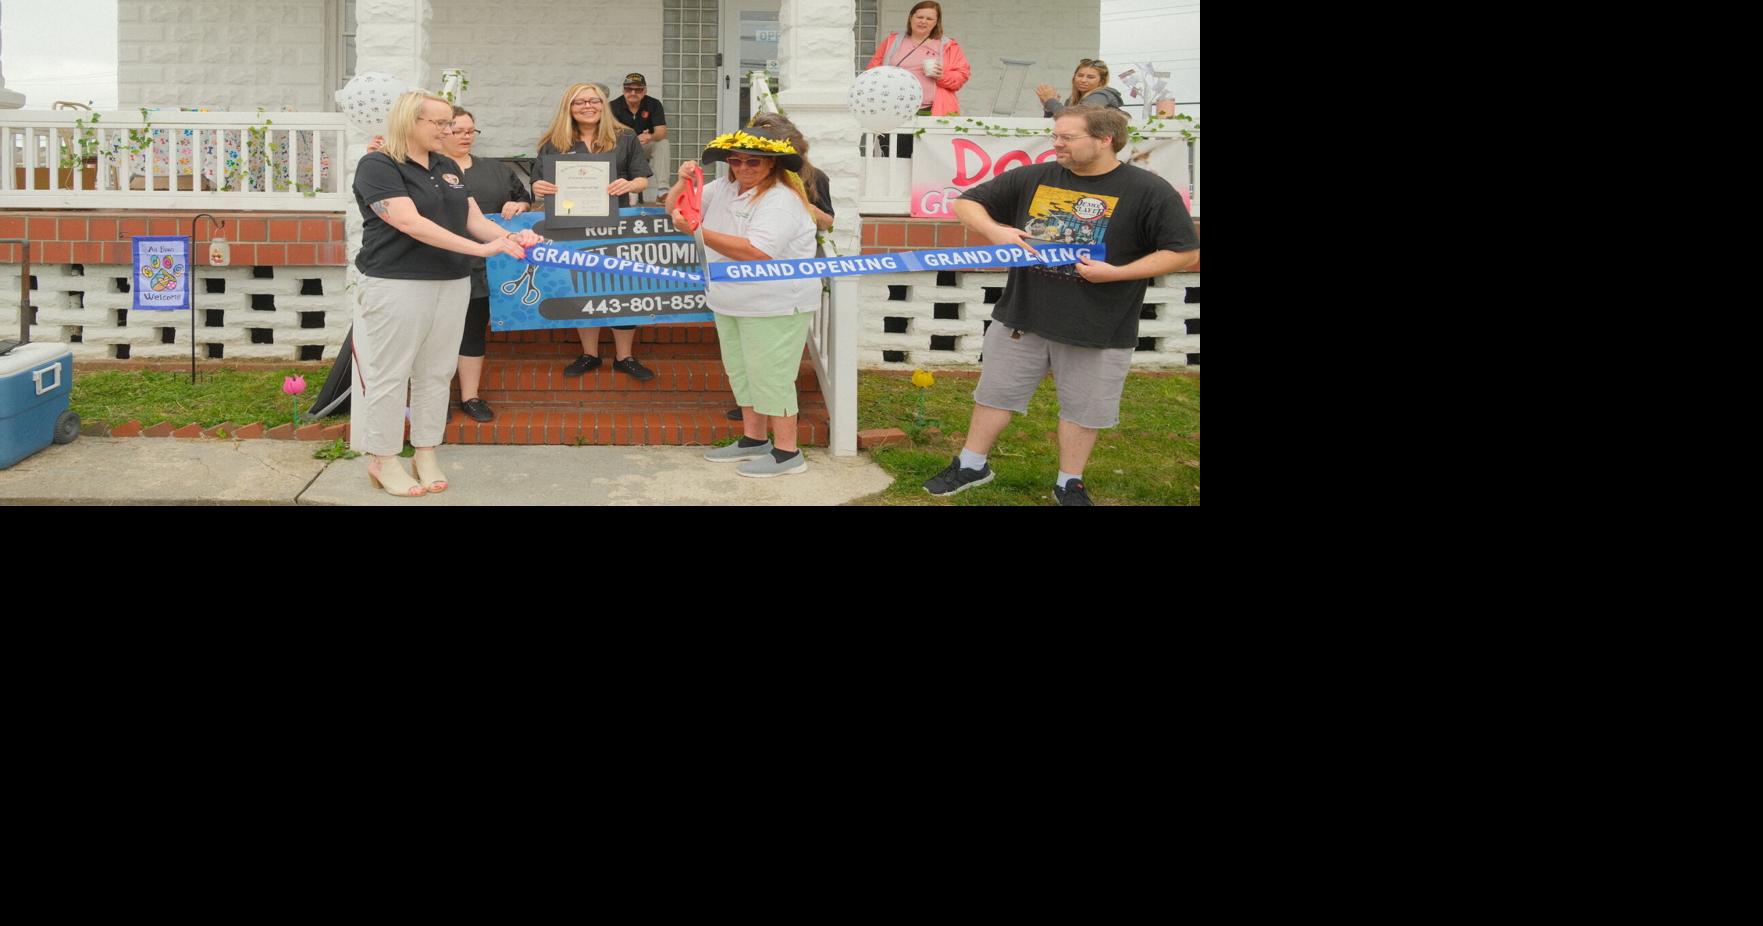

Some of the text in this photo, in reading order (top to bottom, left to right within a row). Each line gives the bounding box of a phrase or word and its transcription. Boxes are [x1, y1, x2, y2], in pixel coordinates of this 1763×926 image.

[633, 219, 649, 234] &
[532, 247, 600, 267] GRAND
[924, 250, 992, 267] GRAND
[726, 256, 897, 279] GRAND OPENING
[144, 292, 182, 301] Welcome
